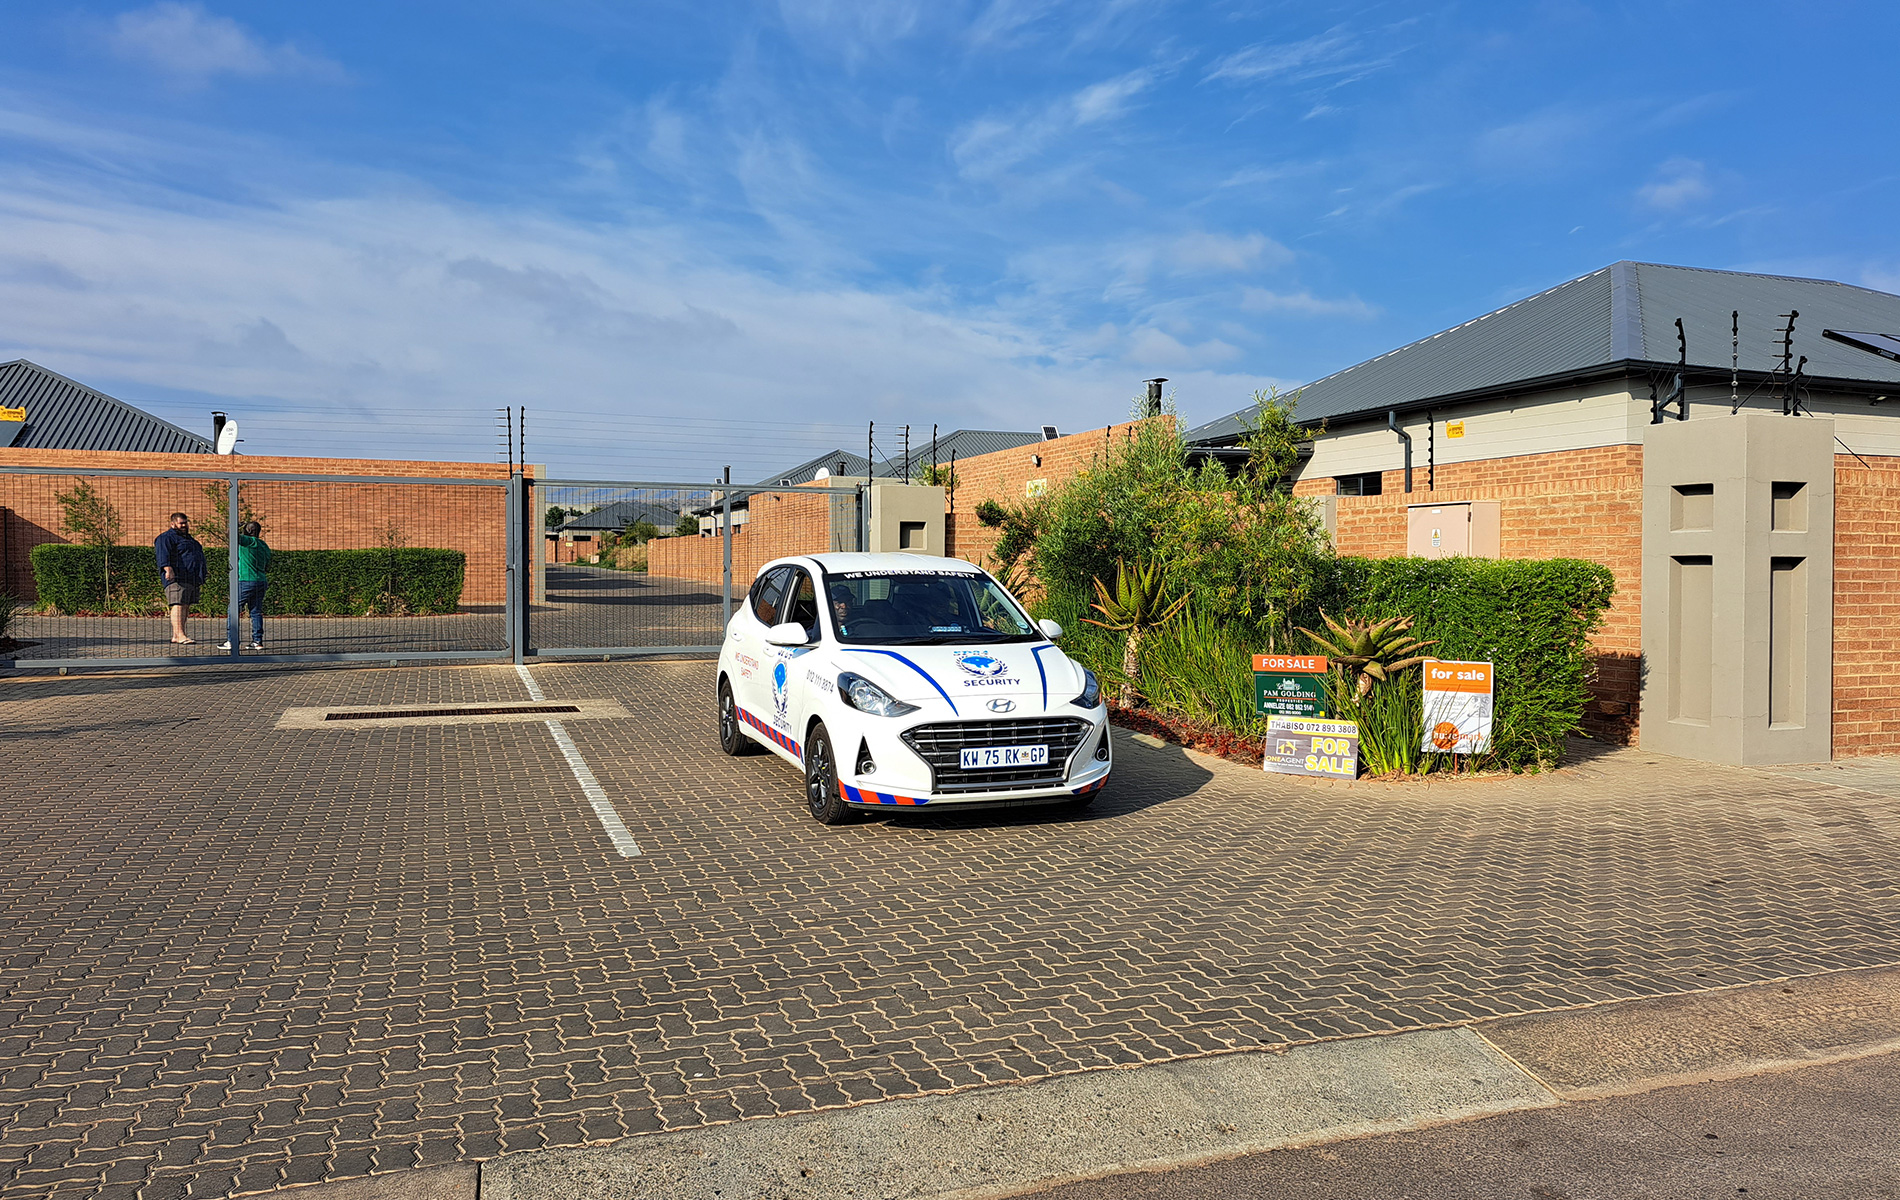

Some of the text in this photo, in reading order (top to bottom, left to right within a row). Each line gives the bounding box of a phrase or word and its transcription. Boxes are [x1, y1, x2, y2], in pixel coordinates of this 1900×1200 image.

[937, 571, 975, 579] SAFETY
[1262, 658, 1315, 669] FOR SALE
[806, 669, 815, 683] 012
[1431, 668, 1485, 681] for sale
[963, 678, 1021, 687] SECURITY
[1280, 690, 1316, 698] GOLDING
[773, 714, 792, 735] SECURITY
[1271, 721, 1357, 734] THABISO 072 893 3808
[1311, 737, 1351, 756] FOR
[985, 749, 999, 765] 75
[1005, 748, 1020, 764] RK
[1031, 747, 1045, 762] GP
[1305, 755, 1355, 776] SALE
